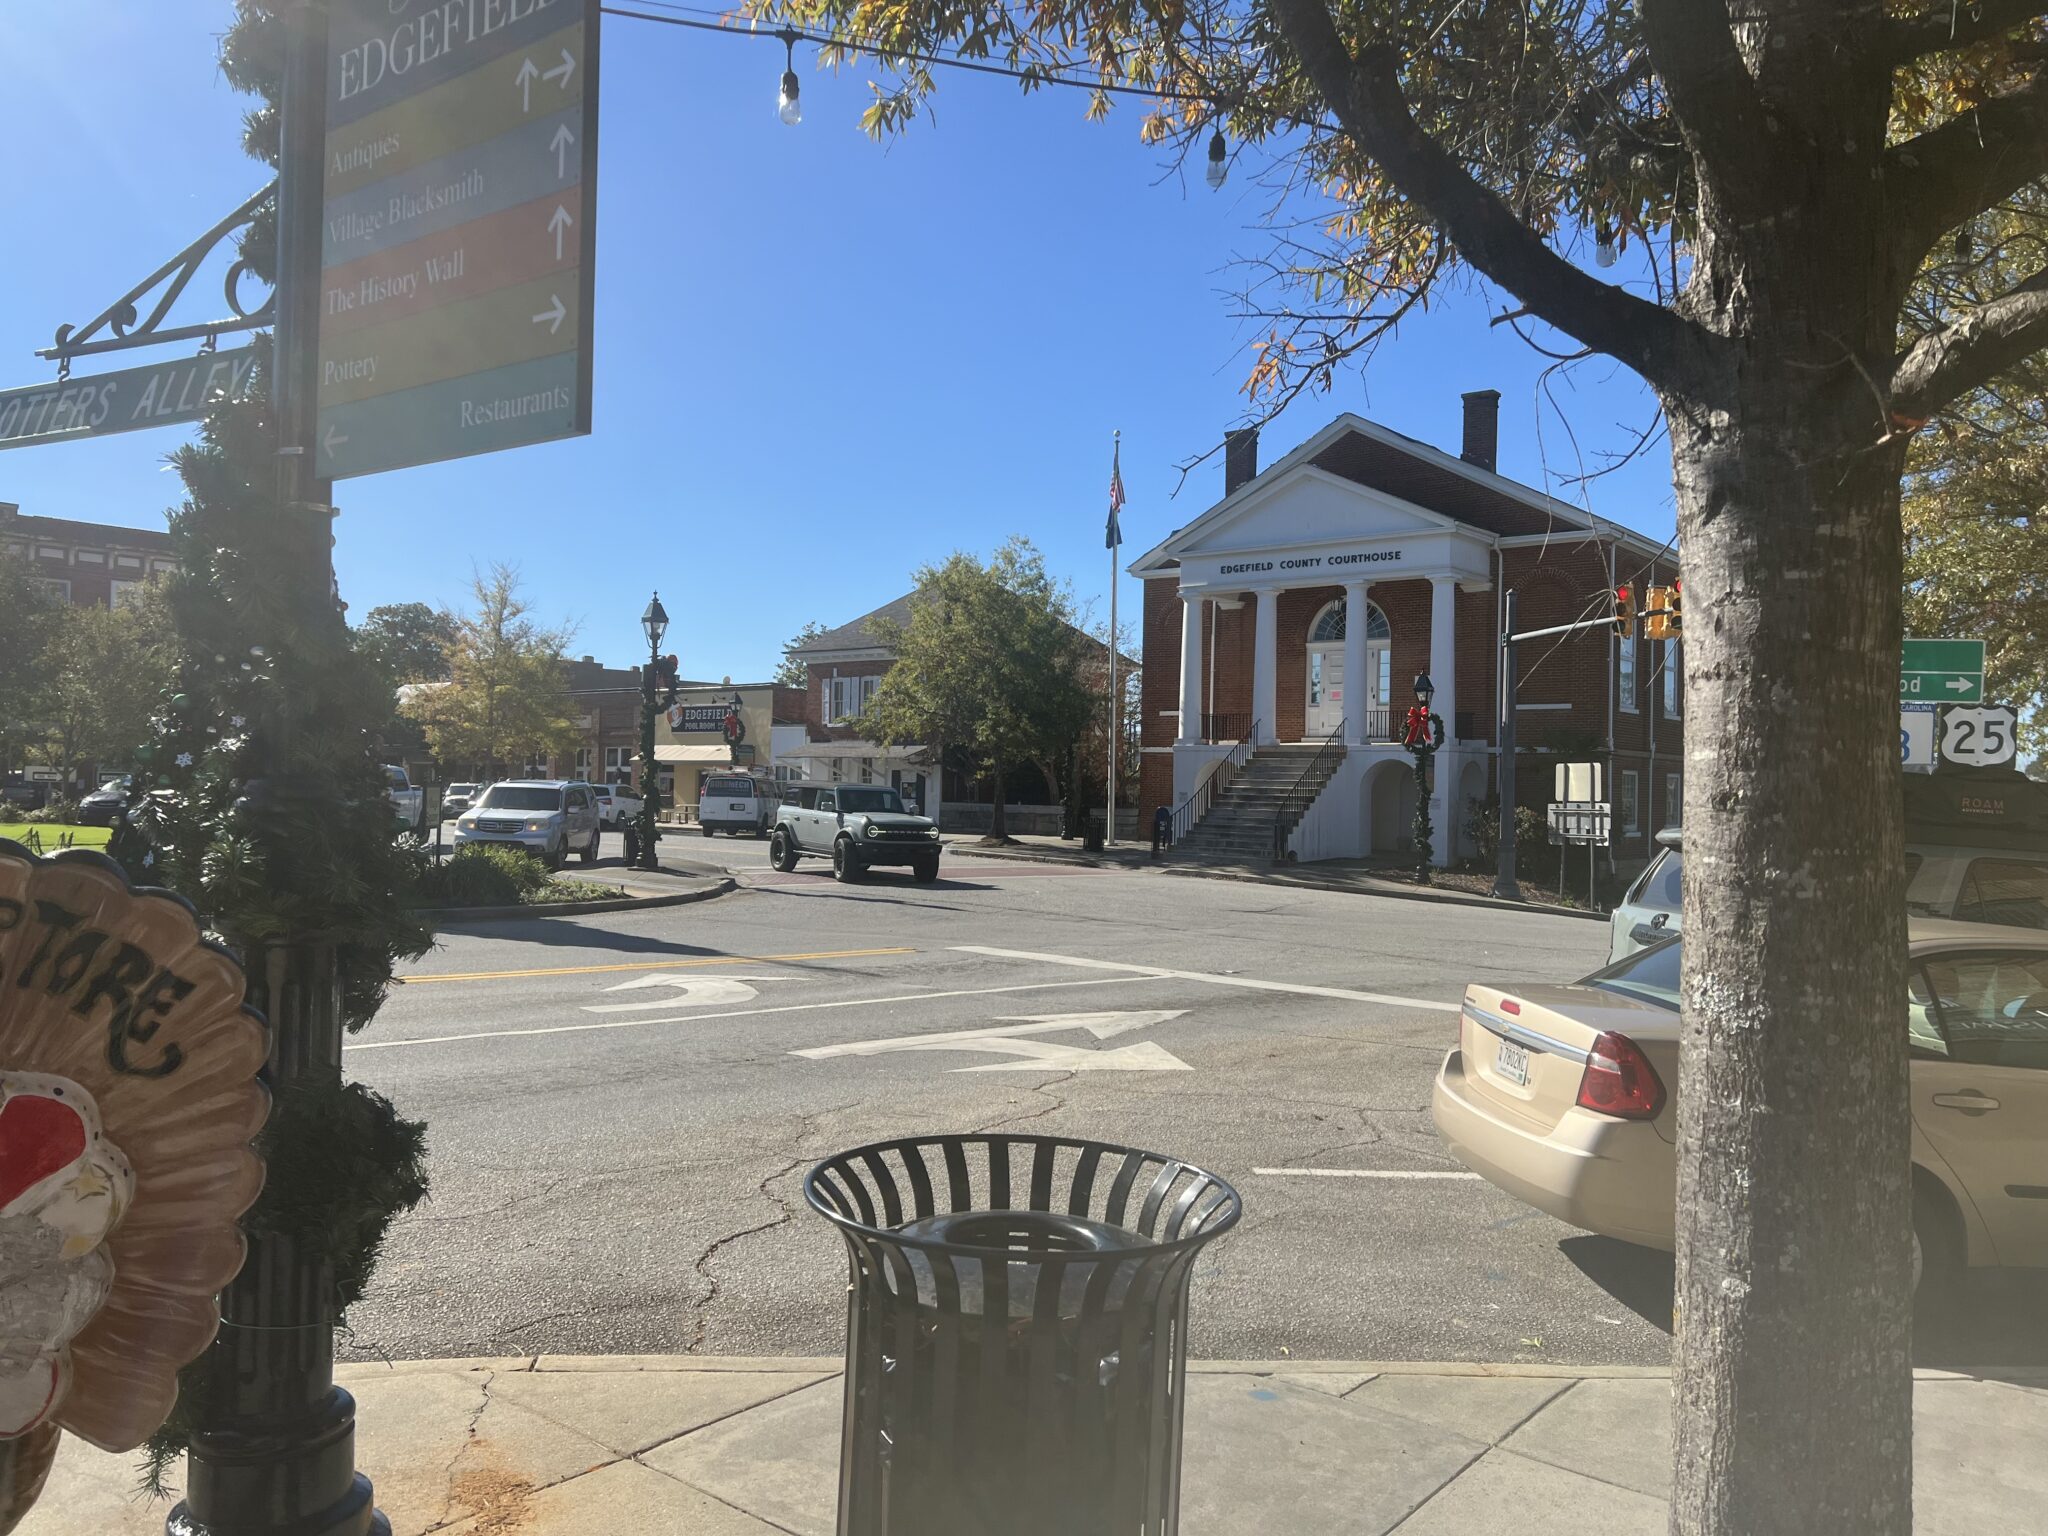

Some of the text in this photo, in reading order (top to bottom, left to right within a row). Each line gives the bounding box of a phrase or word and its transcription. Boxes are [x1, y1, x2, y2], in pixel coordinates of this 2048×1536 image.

[337, 0, 553, 101] EDGEFIEL
[330, 133, 400, 176] Antiques
[329, 168, 484, 243] Village Blacksmith
[327, 249, 464, 315] The History Wall
[324, 354, 379, 386] Pottery
[0, 356, 253, 438] OTTERS ALLEY
[460, 387, 570, 428] Restaurants
[1220, 551, 1402, 574] EDGEFIELD COUNTY COURTHOUSE
[685, 708, 732, 720] EDGEFIELD
[1953, 720, 2004, 754] 25
[1962, 797, 2004, 809] ROAM
